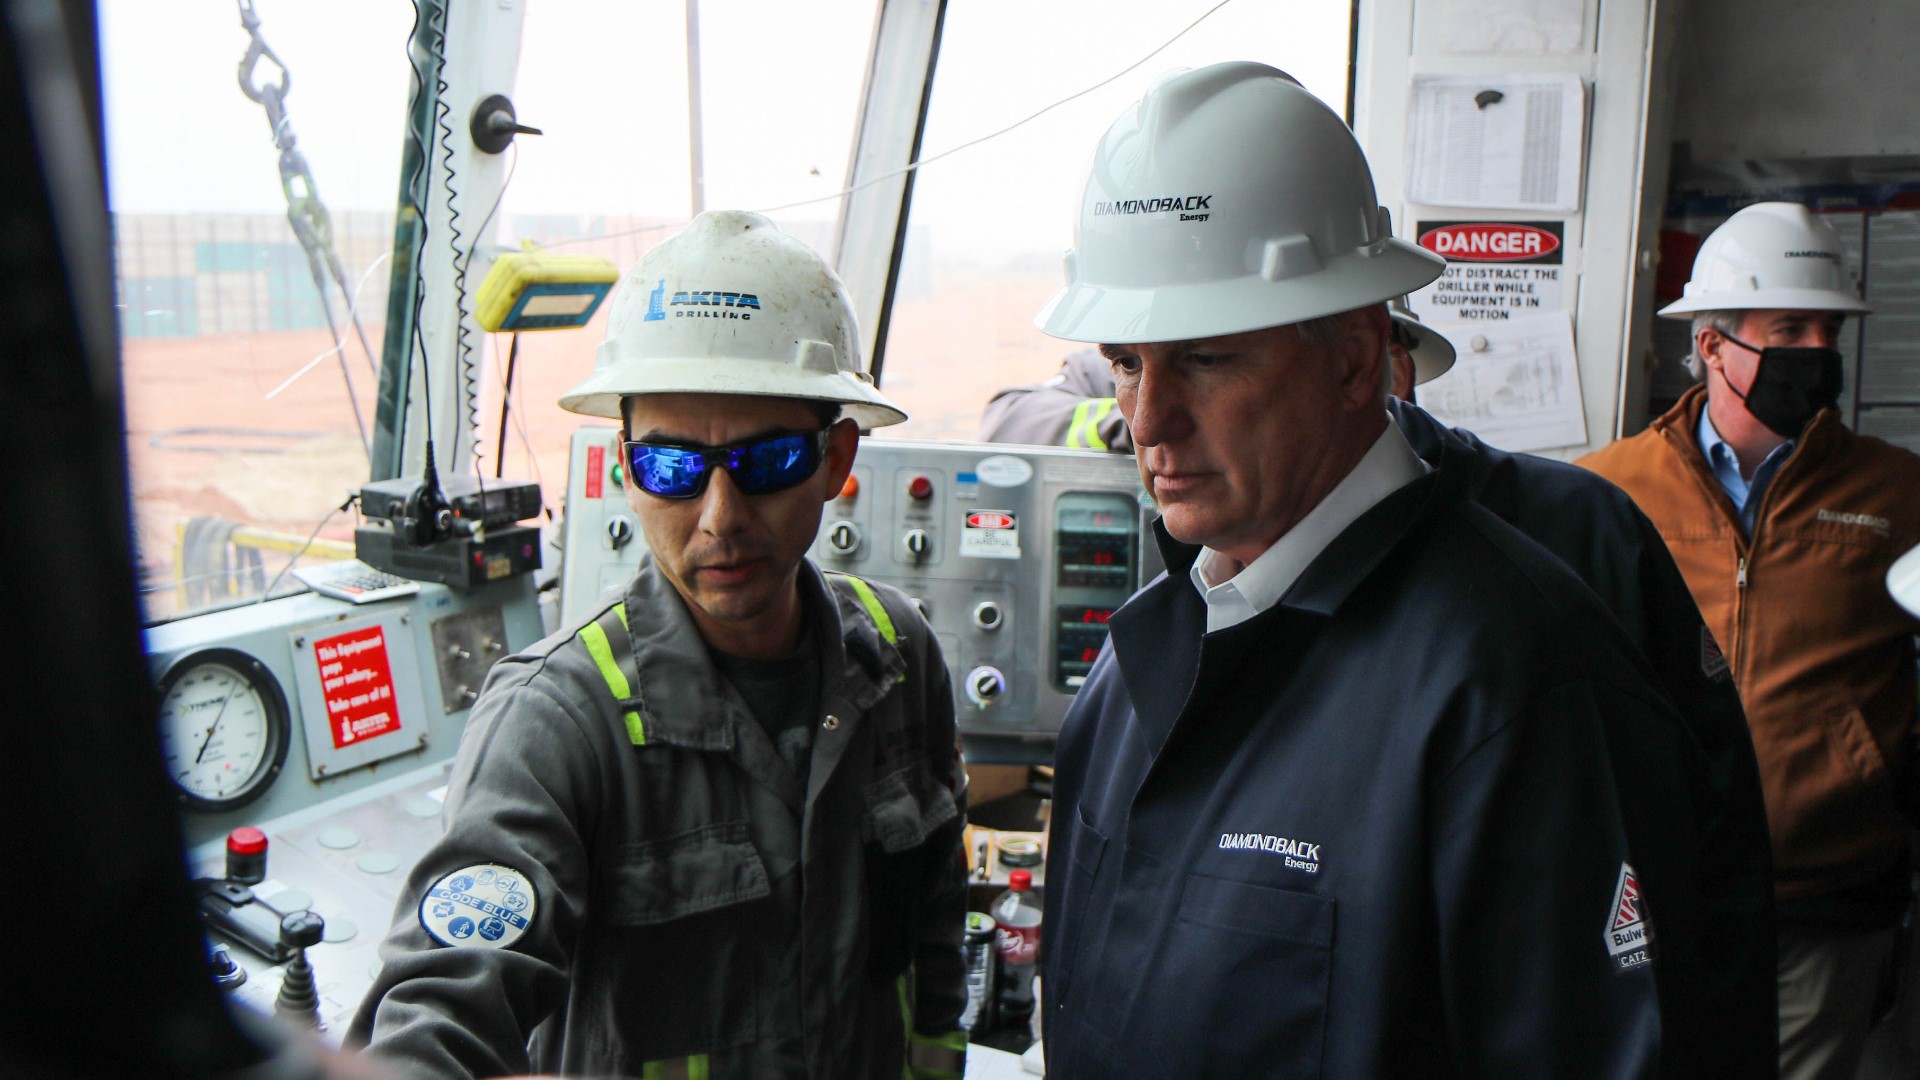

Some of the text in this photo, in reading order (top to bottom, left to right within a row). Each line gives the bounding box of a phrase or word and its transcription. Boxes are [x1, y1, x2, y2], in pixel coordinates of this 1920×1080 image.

[1094, 195, 1213, 216] DIAMONDBACK
[1180, 213, 1210, 222] Energy
[1435, 231, 1541, 253] DANGER
[1466, 268, 1528, 280] DISTRACT
[1535, 269, 1558, 280] THE
[1438, 281, 1534, 293] DRILLER WHILE
[670, 291, 761, 310] AKITA
[1432, 295, 1539, 307] EQUIPMENT IS IN
[676, 310, 751, 320] DRILLING
[1459, 308, 1509, 320] MOTION
[1219, 833, 1320, 861] DIAMONDBACK
[1284, 856, 1319, 873] Energy
[440, 890, 521, 925] CODE BLUE
